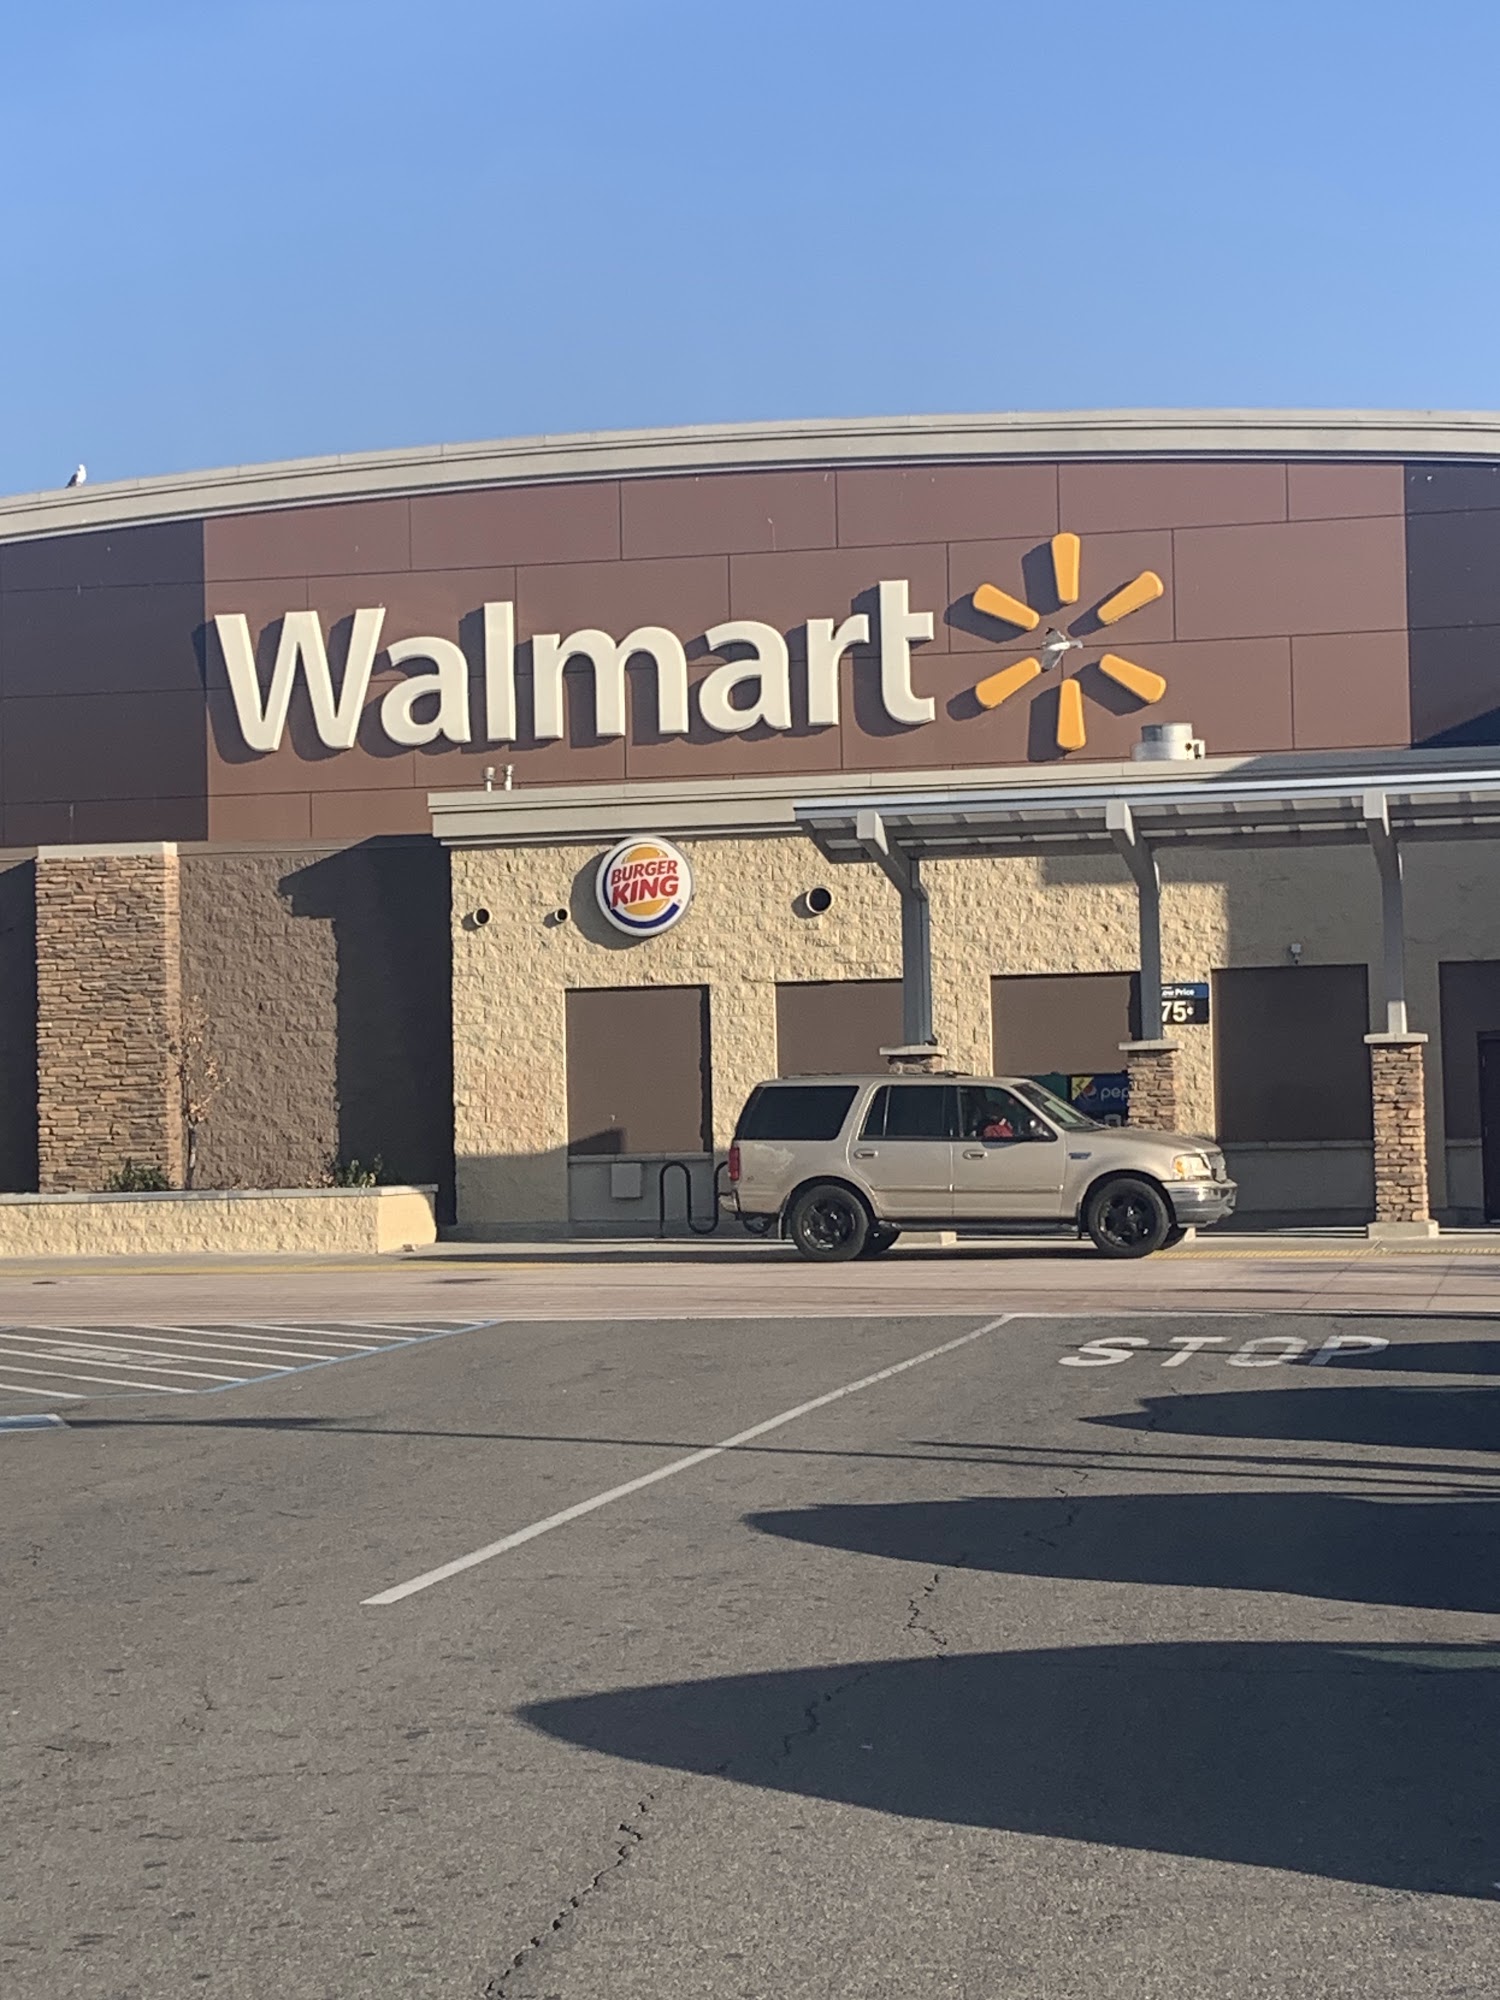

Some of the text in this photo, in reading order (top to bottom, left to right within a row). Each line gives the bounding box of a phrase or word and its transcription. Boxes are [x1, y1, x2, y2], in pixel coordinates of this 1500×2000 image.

[214, 579, 936, 752] Walmart
[611, 859, 678, 887] BURGER
[611, 875, 680, 908] KING
[1101, 1087, 1129, 1101] pep
[1058, 1335, 1390, 1368] STOP
